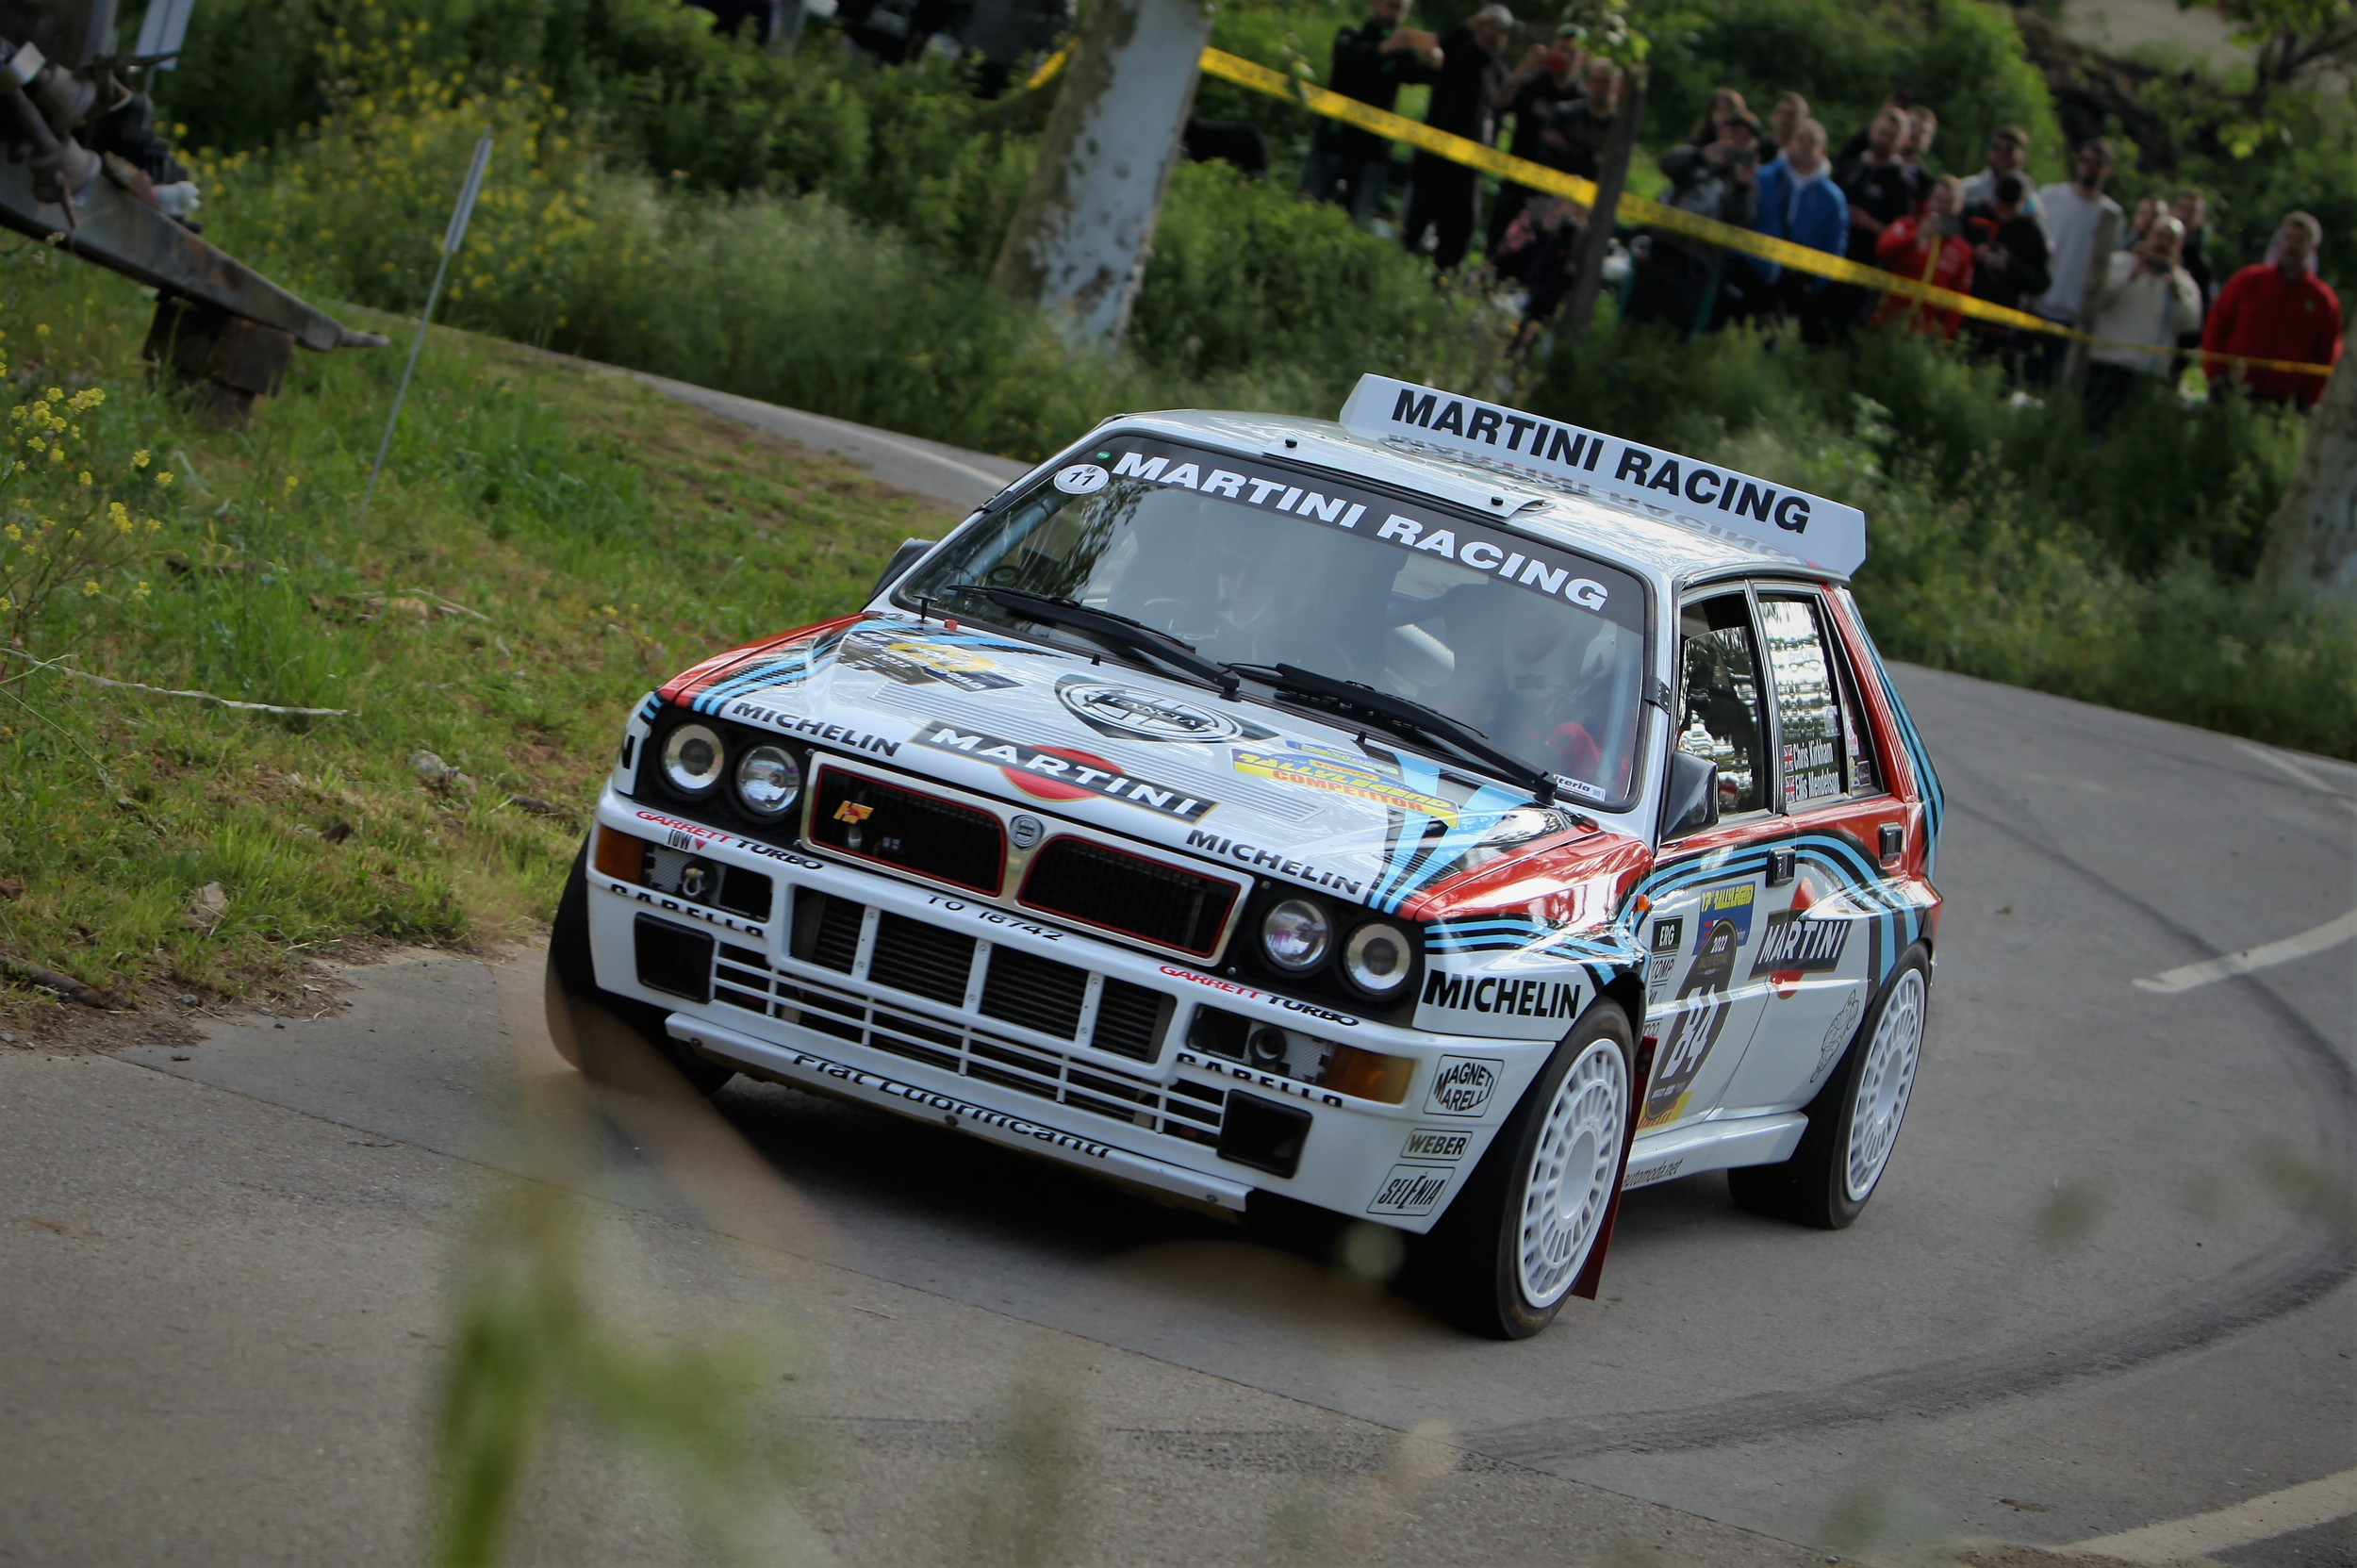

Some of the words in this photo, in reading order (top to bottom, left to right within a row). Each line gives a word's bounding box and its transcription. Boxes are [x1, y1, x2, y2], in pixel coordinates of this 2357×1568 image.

[1068, 471, 1096, 486] 11
[1393, 388, 1605, 470] MARTINI
[1617, 448, 1811, 535] RACING
[1112, 452, 1368, 529] MARTINI
[1376, 514, 1609, 612] RACING
[733, 702, 901, 757] MICHELIN
[930, 728, 1198, 815] MARTINI
[1238, 753, 1453, 808] RALLYLEGEND
[1272, 769, 1425, 813] COMPETITOR
[635, 811, 734, 842] GARRETT
[736, 838, 823, 869] TURBO
[668, 829, 692, 850] TOW
[1186, 829, 1363, 895] MICHELIN
[928, 895, 965, 911] TO
[979, 911, 1063, 941] 18742
[1659, 924, 1675, 947] ERG
[1757, 920, 1848, 965] MARTINI
[1710, 934, 1729, 954] 2022
[1159, 966, 1263, 999] GARRETT
[1267, 994, 1360, 1027] TURBO
[1422, 970, 1581, 1020] MICHELIN
[1408, 1134, 1467, 1156] WEBER
